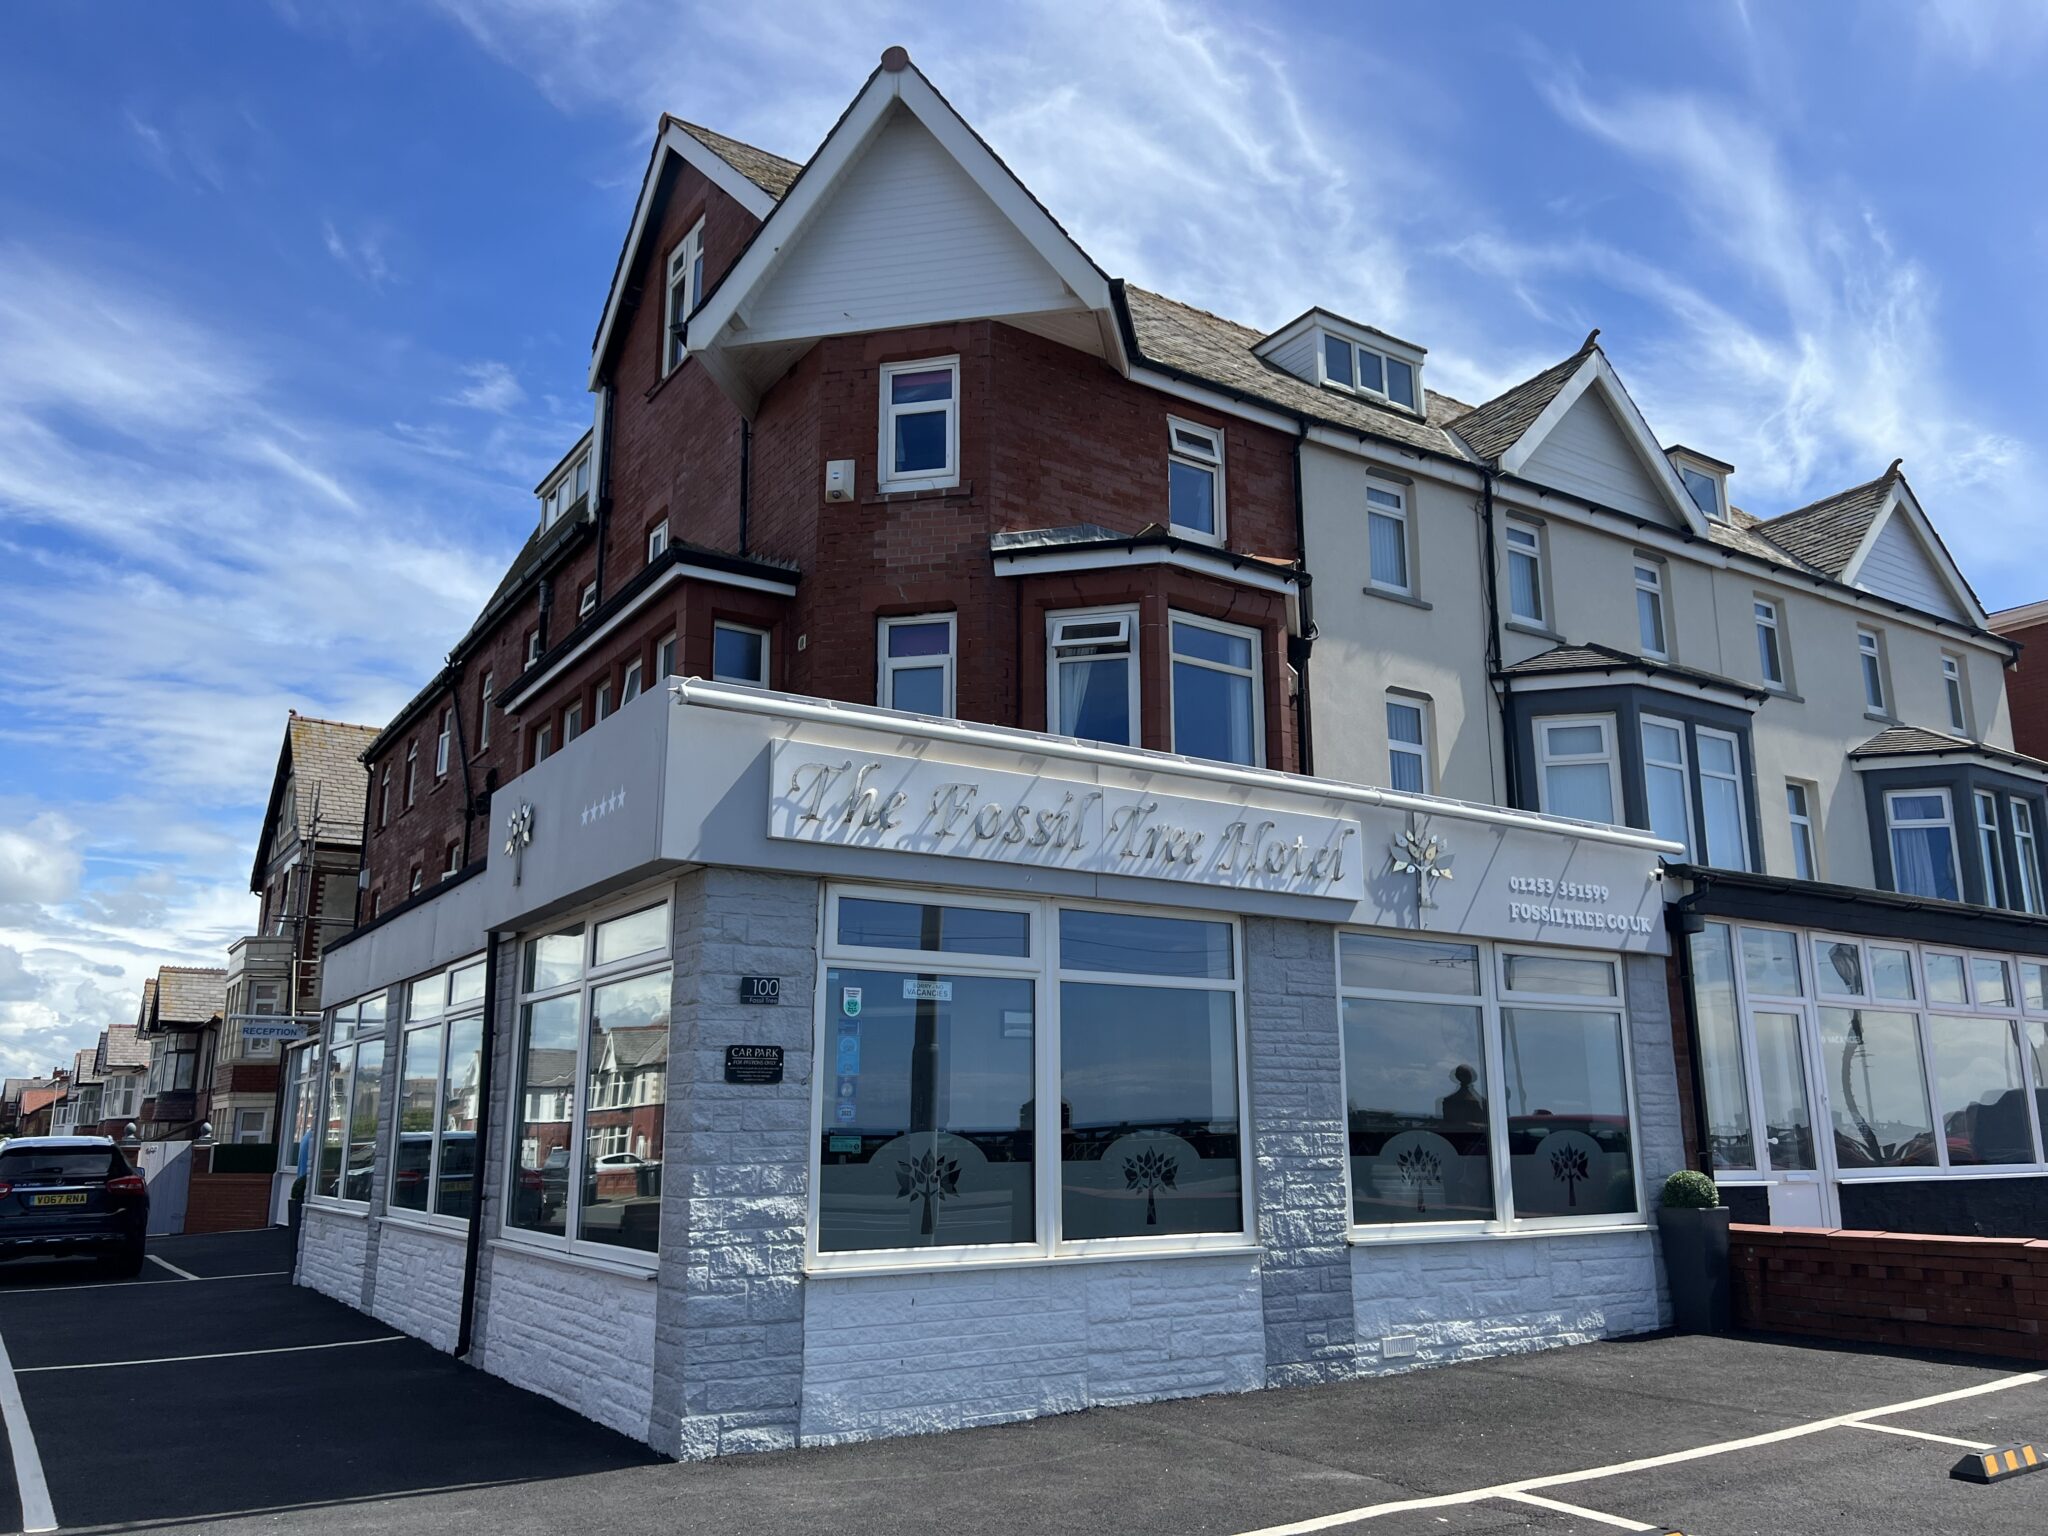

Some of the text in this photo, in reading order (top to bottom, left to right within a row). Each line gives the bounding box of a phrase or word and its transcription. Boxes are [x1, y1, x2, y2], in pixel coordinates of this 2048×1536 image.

[791, 760, 1356, 882] The Fossil Tree Hotel
[1510, 876, 1609, 900] 01253 351599
[753, 979, 779, 996] 100
[907, 988, 949, 998] VACANCIES
[243, 1027, 297, 1036] RECEPTION
[731, 1048, 779, 1058] CAR PARK
[65, 1194, 85, 1204] RNA
